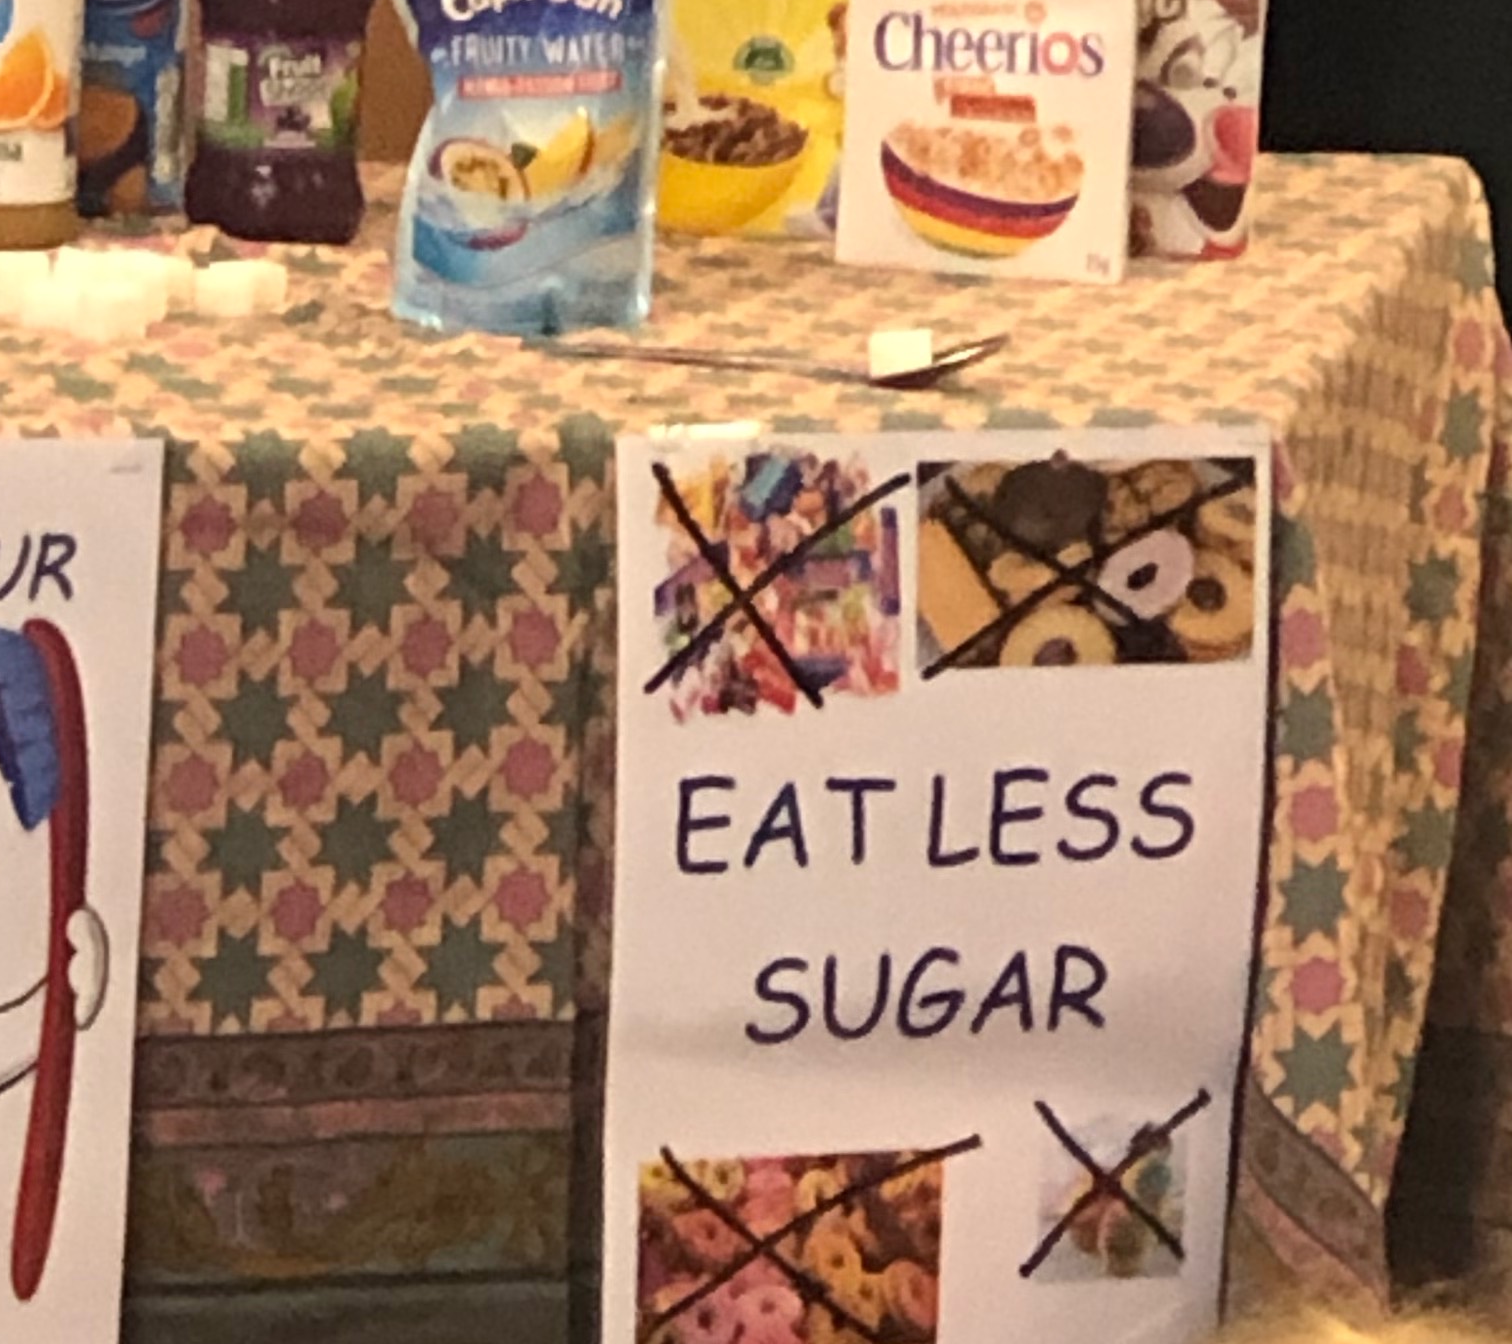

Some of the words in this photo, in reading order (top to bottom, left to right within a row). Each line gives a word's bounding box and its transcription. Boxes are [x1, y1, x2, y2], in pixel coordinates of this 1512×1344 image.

[451, 33, 532, 67] FRUITY
[542, 30, 625, 67] WATER
[874, 10, 1105, 76] Cheerios
[676, 774, 896, 874] EAT
[927, 767, 1195, 868] LESS
[744, 943, 1108, 1045] SUGAR
